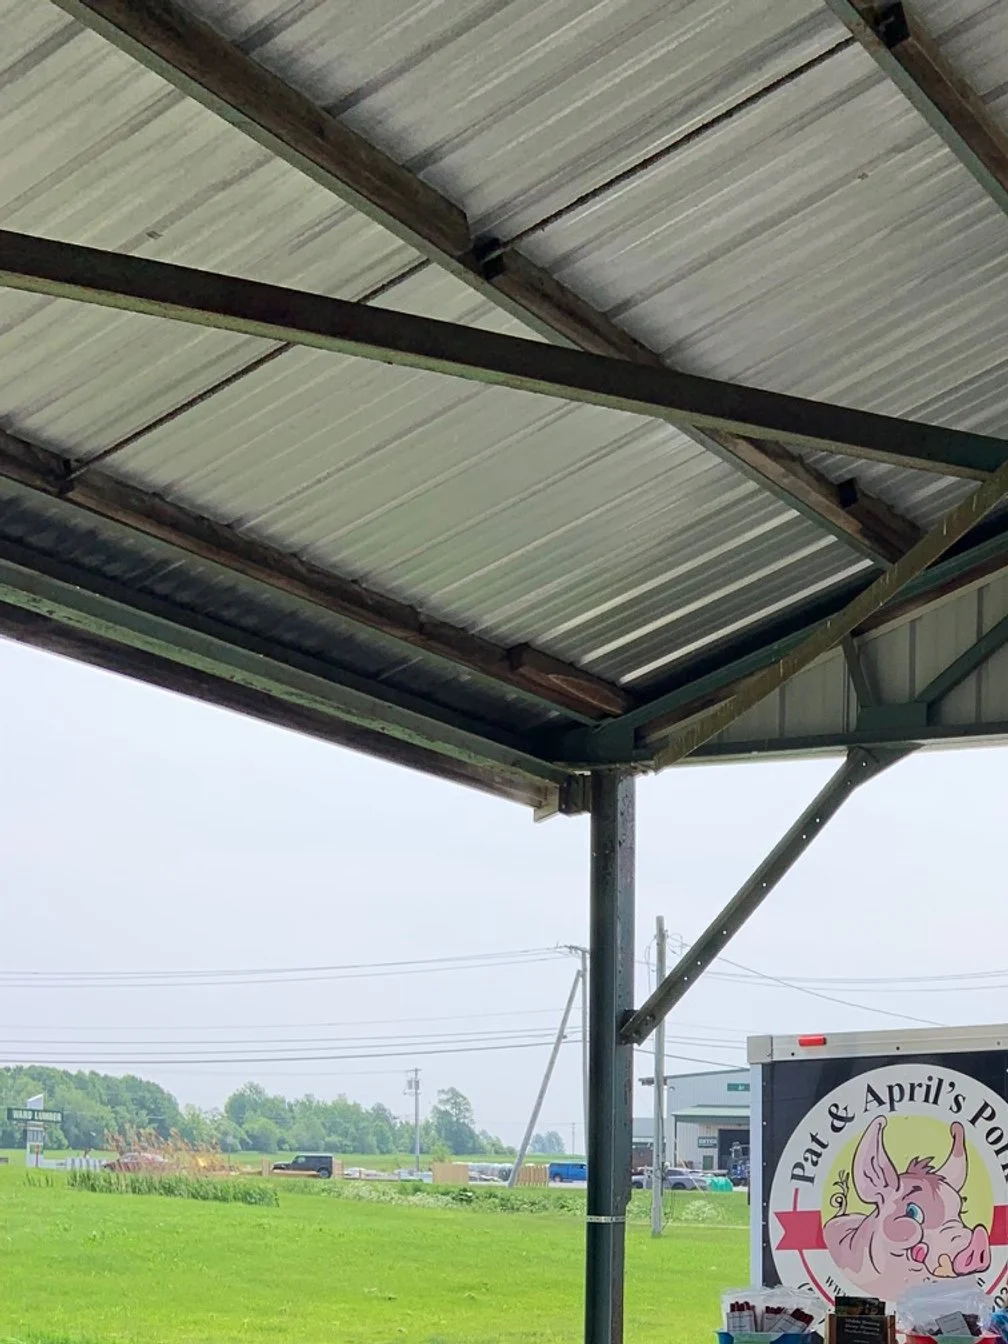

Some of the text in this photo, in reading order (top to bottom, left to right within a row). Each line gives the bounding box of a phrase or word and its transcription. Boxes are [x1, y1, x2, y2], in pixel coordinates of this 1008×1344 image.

[790, 1132, 830, 1185] Pat
[828, 1103, 855, 1133] &
[863, 1075, 966, 1114] April's
